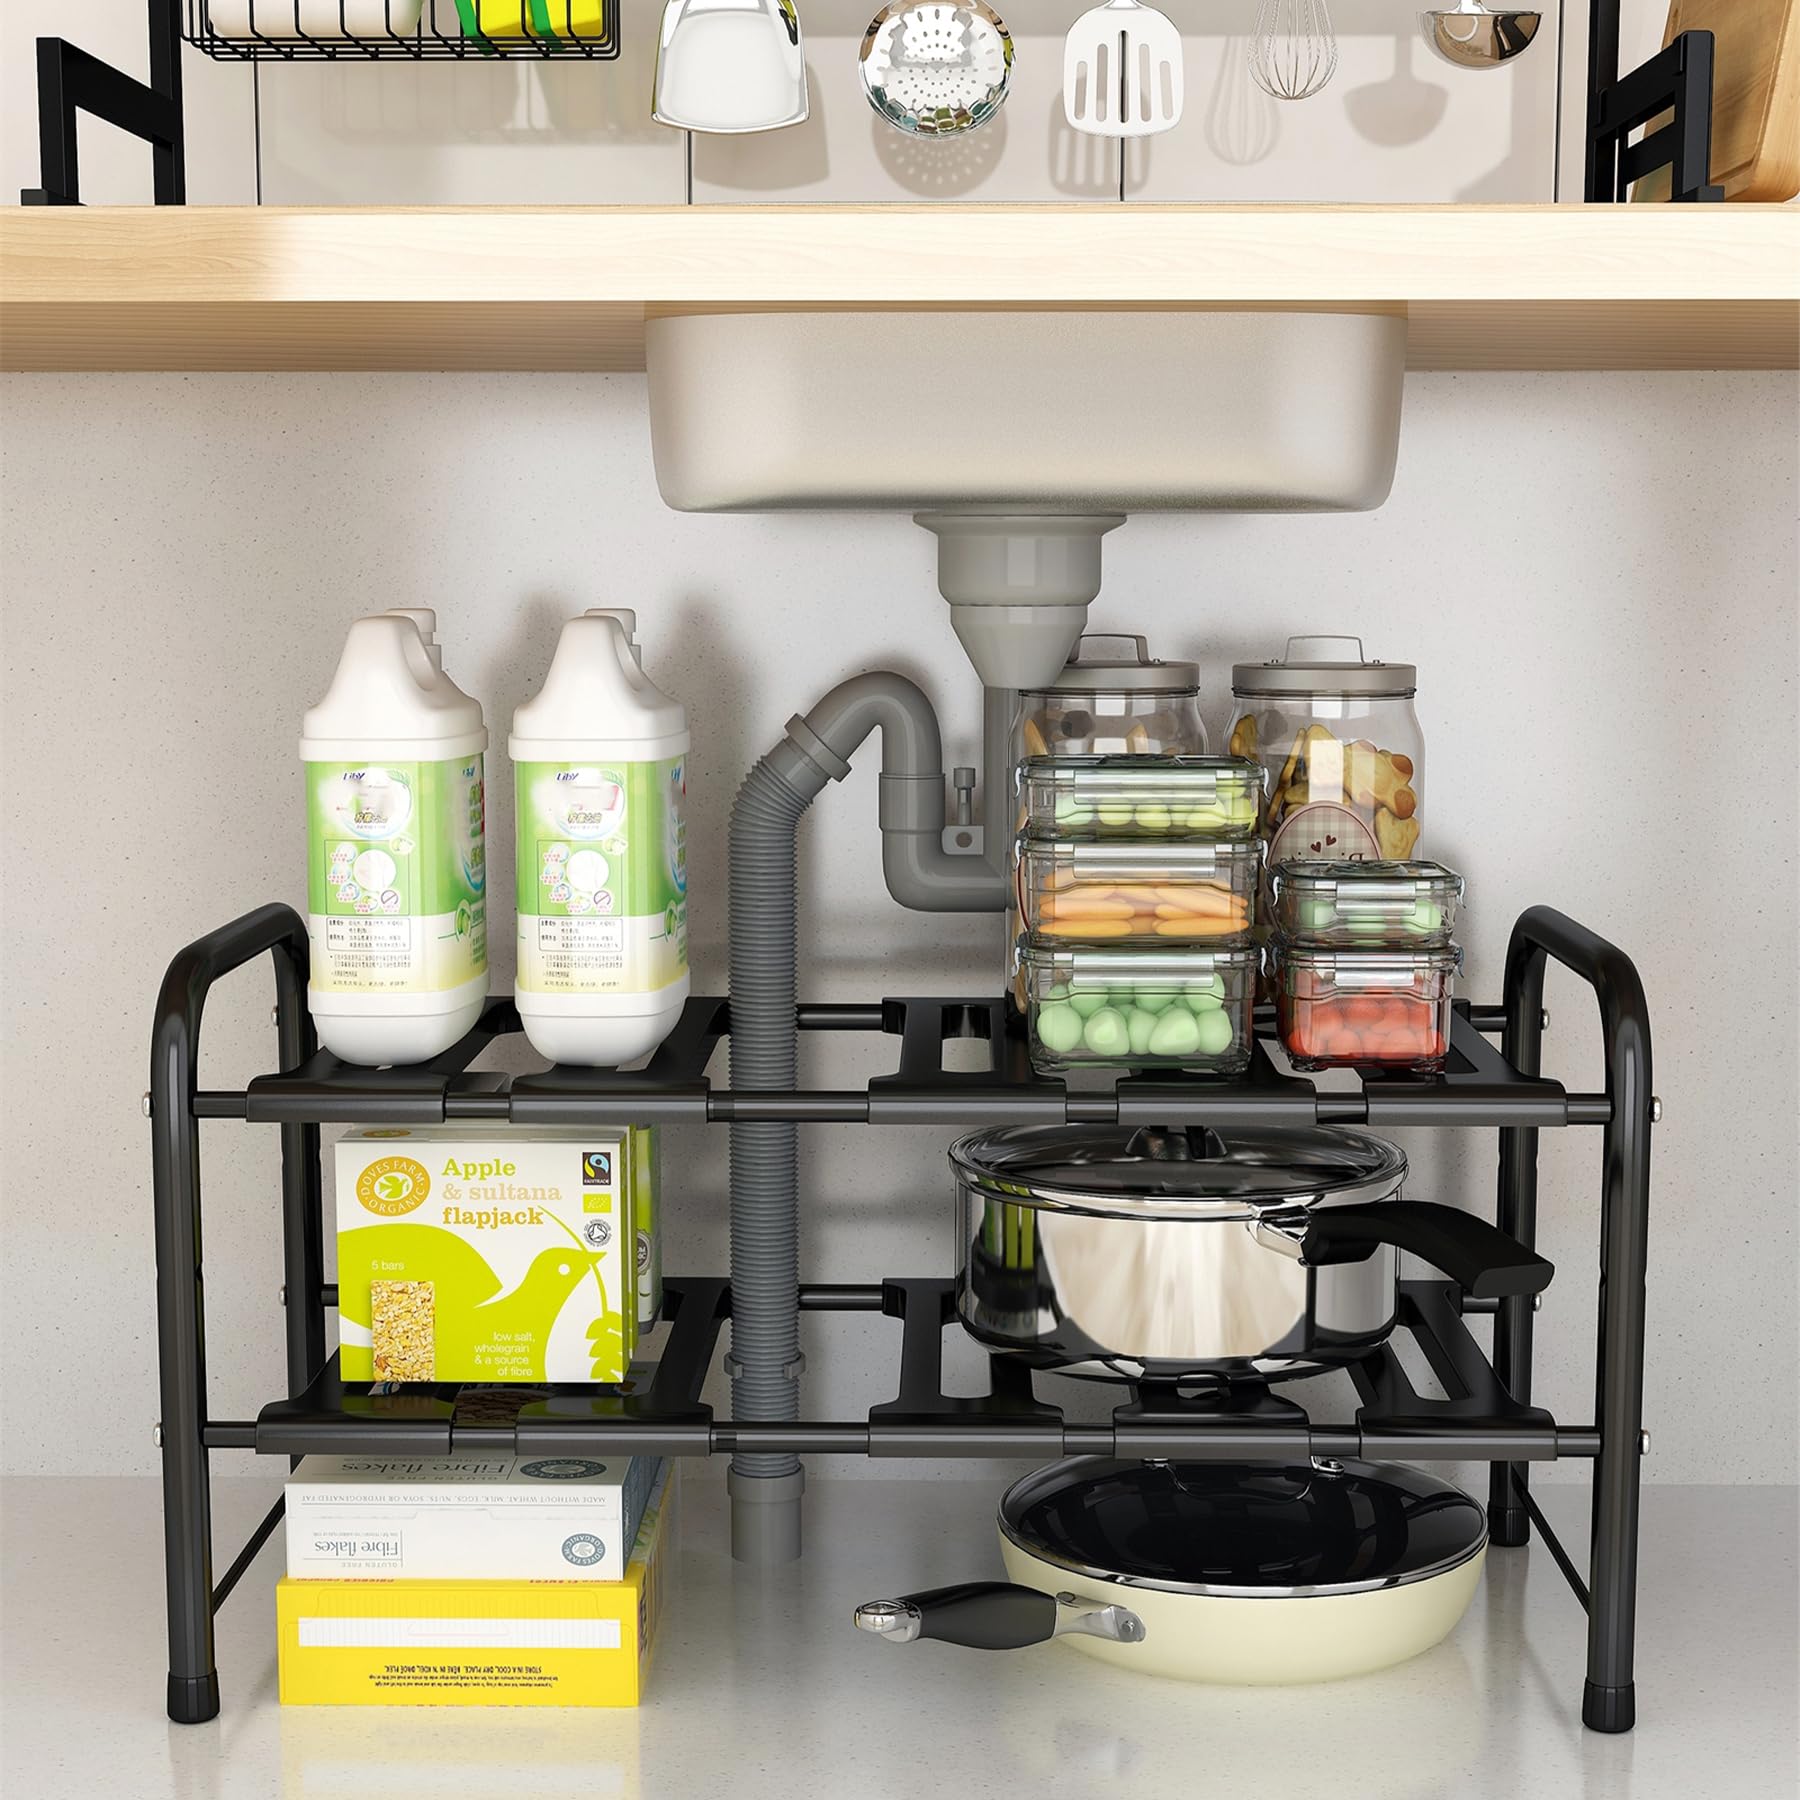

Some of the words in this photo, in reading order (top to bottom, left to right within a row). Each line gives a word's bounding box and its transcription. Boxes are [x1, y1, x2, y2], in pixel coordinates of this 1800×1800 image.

[441, 1157, 516, 1181] Apple
[360, 1161, 390, 1196] DOVES
[393, 1159, 425, 1184] FARM
[442, 1183, 462, 1201] &
[469, 1183, 563, 1201] sultana
[368, 1187, 425, 1214] ORGANIC
[442, 1206, 544, 1230] flapjack
[371, 1259, 379, 1271] 5
[381, 1259, 405, 1271] bars
[493, 1331, 513, 1342] low
[474, 1344, 530, 1356] wholegrain
[474, 1354, 482, 1365] &
[484, 1356, 492, 1365] a
[494, 1356, 529, 1365] source
[497, 1366, 508, 1377] of
[510, 1366, 534, 1377] fibre
[342, 1463, 424, 1474] flakes
[432, 1463, 505, 1474] Fibre
[314, 1541, 357, 1557] flakes
[360, 1541, 398, 1557] Fibre
[525, 1665, 542, 1674] STORE
